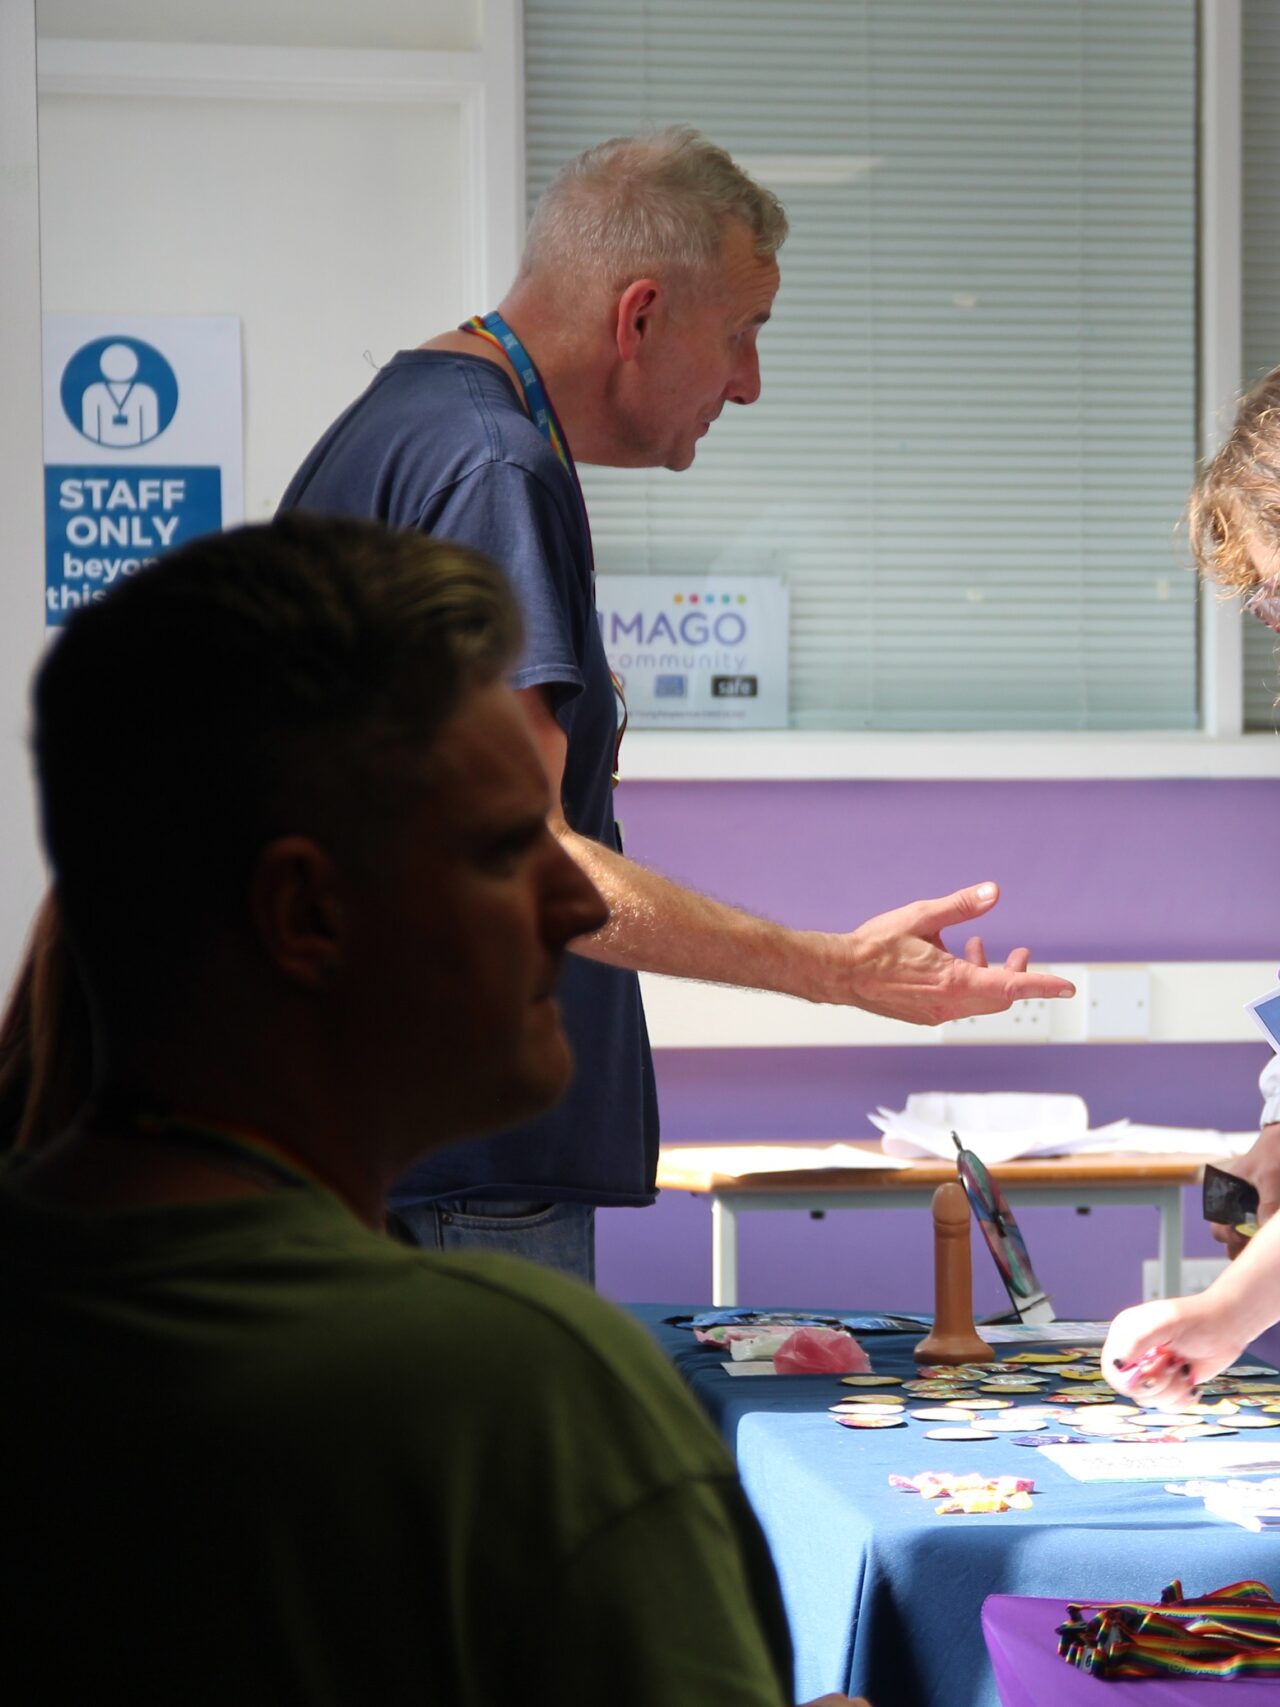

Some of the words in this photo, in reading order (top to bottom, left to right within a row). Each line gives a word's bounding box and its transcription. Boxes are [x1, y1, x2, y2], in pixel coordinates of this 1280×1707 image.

[59, 478, 185, 511] STAFF
[65, 515, 180, 547] ONLY
[63, 552, 160, 583] beyo
[597, 611, 747, 646] IMAGO
[717, 679, 751, 695] safe
